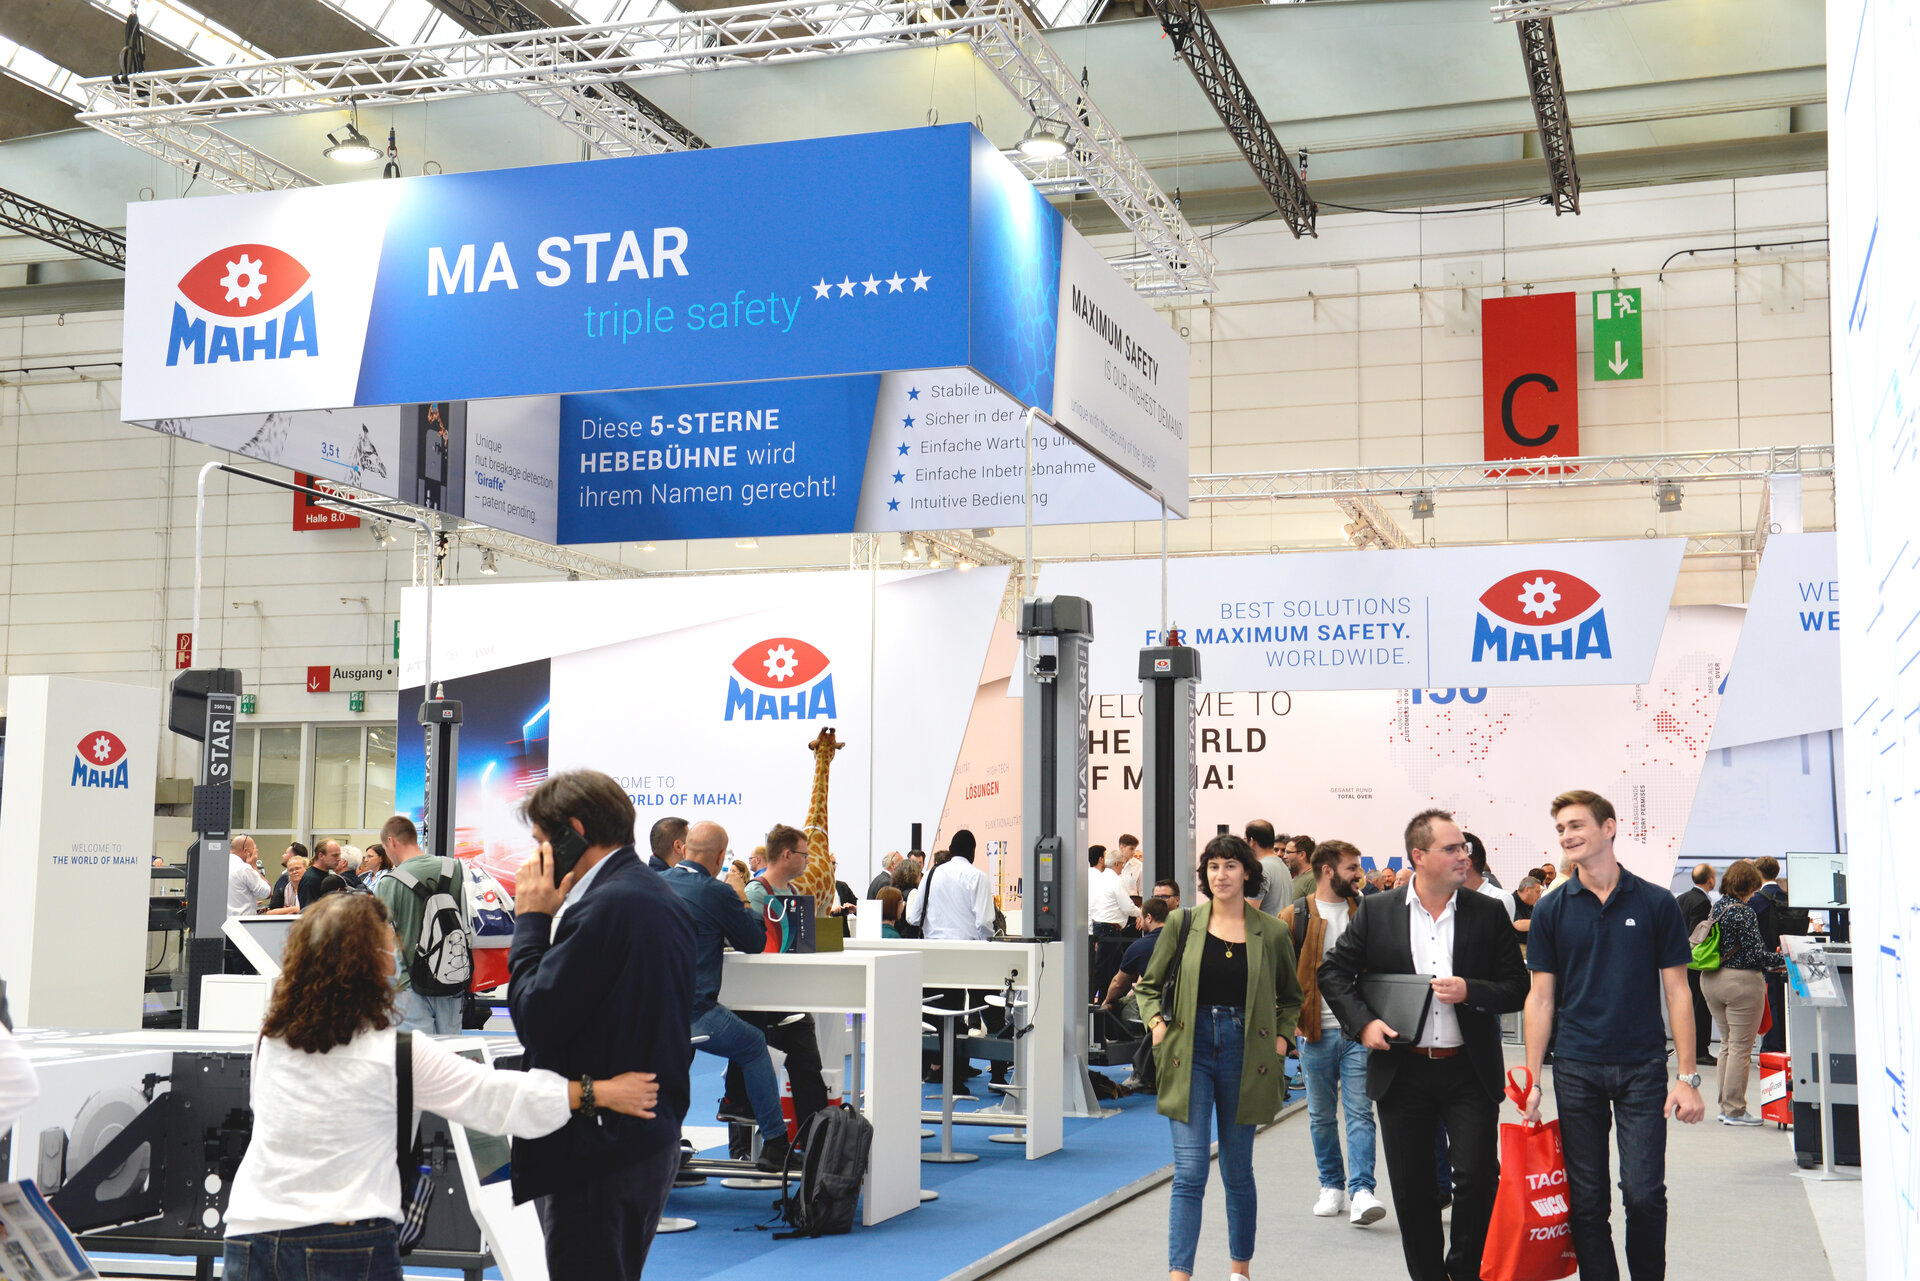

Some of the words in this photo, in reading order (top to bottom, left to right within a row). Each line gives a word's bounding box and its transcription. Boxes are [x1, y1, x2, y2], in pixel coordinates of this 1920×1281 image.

[428, 241, 519, 296] MA
[536, 226, 689, 287] STAR
[166, 290, 319, 366] MAHA
[584, 298, 675, 345] triple
[687, 290, 801, 333] safety
[1072, 284, 1122, 354] MAXIMUM
[1125, 335, 1159, 385] SAFETY
[931, 383, 980, 398] Stabile
[1104, 357, 1112, 381] IS
[1113, 366, 1127, 394] OUR
[1129, 379, 1157, 418] HIGHEST
[1158, 401, 1183, 440] DEMAND
[925, 412, 970, 426] Sicher
[975, 410, 987, 423] in
[991, 408, 1015, 422] der
[1501, 373, 1559, 447] C
[582, 417, 643, 440] Diese
[650, 408, 780, 436] 5-STERNE
[320, 441, 334, 458] 3,5
[335, 448, 340, 459] t
[475, 432, 502, 454] Unique
[920, 438, 982, 454] Einfache
[986, 436, 1048, 451] Wartung
[580, 444, 737, 474] HEBEBÜHNE
[746, 441, 795, 466] wird
[475, 454, 487, 469] nut
[488, 457, 521, 480] breakage
[522, 470, 554, 489] detection
[915, 466, 977, 482] Einfache
[981, 460, 1096, 479] Inbetrebnahme
[579, 486, 642, 507] ihrem
[651, 483, 733, 505] Namen
[741, 475, 837, 506] gerecht!
[910, 495, 968, 509] Intuitive
[972, 491, 1048, 507] Bedienung
[482, 495, 506, 513] patent
[306, 514, 328, 523] Halle
[330, 513, 346, 522] 8.0
[1220, 602, 1275, 619] BEST
[1283, 597, 1411, 618] SOLUTIONS
[1196, 625, 1308, 645] MAXIMUM
[1317, 623, 1411, 641] SAFETY.
[1472, 607, 1612, 662] MAHA
[1266, 647, 1411, 667] WORLDWIDE.
[333, 667, 383, 681] Ausgang
[724, 672, 837, 721] MAHA
[1079, 665, 1087, 741] STAR
[1249, 691, 1291, 716] TO
[210, 720, 231, 777] STAR
[1089, 730, 1130, 754] HE
[1202, 728, 1266, 753] RLD
[71, 754, 128, 789] MAHA
[657, 776, 675, 788] TO
[629, 794, 664, 806] ORLD
[669, 793, 688, 805] OF
[693, 793, 742, 805] MAHA!
[965, 781, 999, 800] LÖSUNGEN
[1079, 766, 1087, 814] MA
[1189, 784, 1195, 825] MA
[53, 856, 69, 865] THE
[71, 856, 99, 865] WORLD
[100, 856, 111, 865] OF
[112, 856, 138, 865] MAHA!
[71, 843, 110, 853] WELCOME
[112, 843, 122, 853] TO
